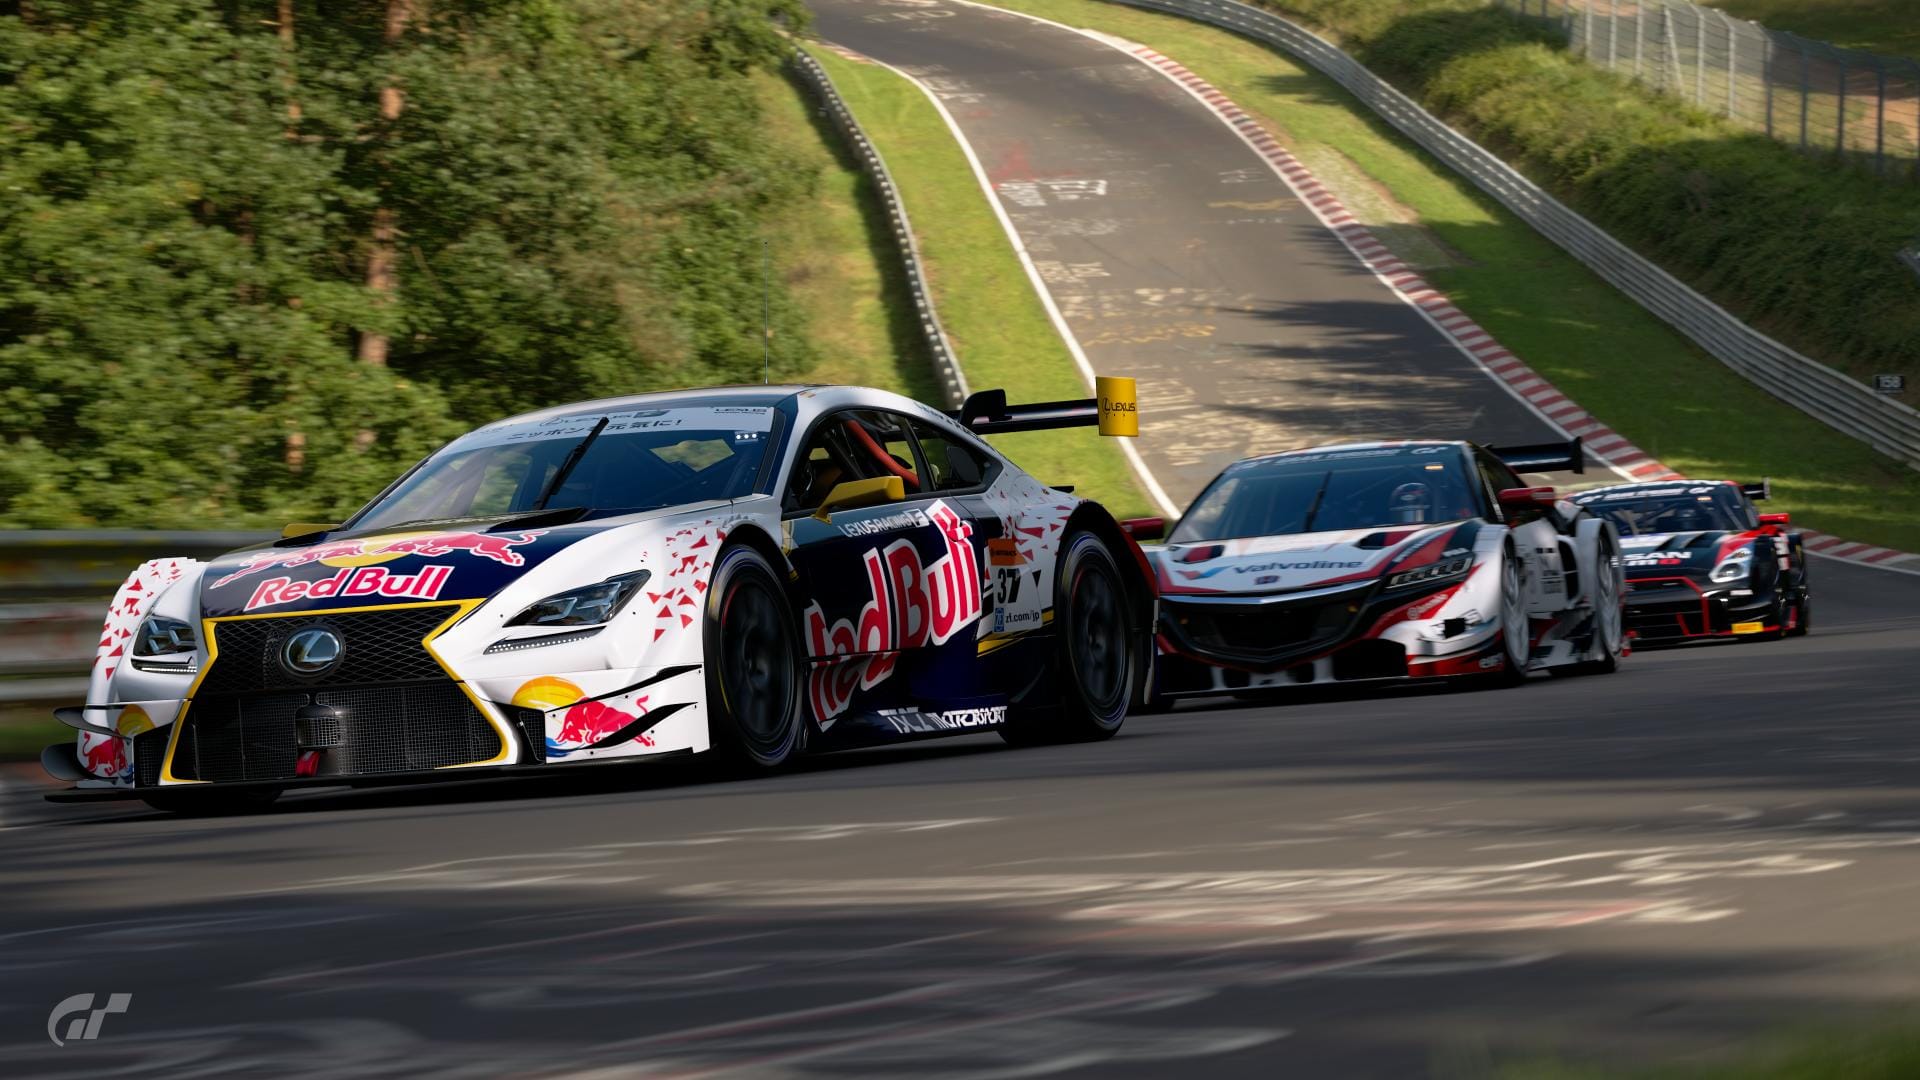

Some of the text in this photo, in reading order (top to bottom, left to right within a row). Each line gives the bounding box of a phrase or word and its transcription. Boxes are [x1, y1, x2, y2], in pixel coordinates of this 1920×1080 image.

[1111, 402, 1136, 412] LEXUS
[507, 419, 683, 440] ニッポン元気に!
[883, 500, 982, 650] Bull
[1234, 560, 1363, 574] Valvoline
[244, 565, 454, 611] Red Bull
[997, 568, 1021, 604] 37
